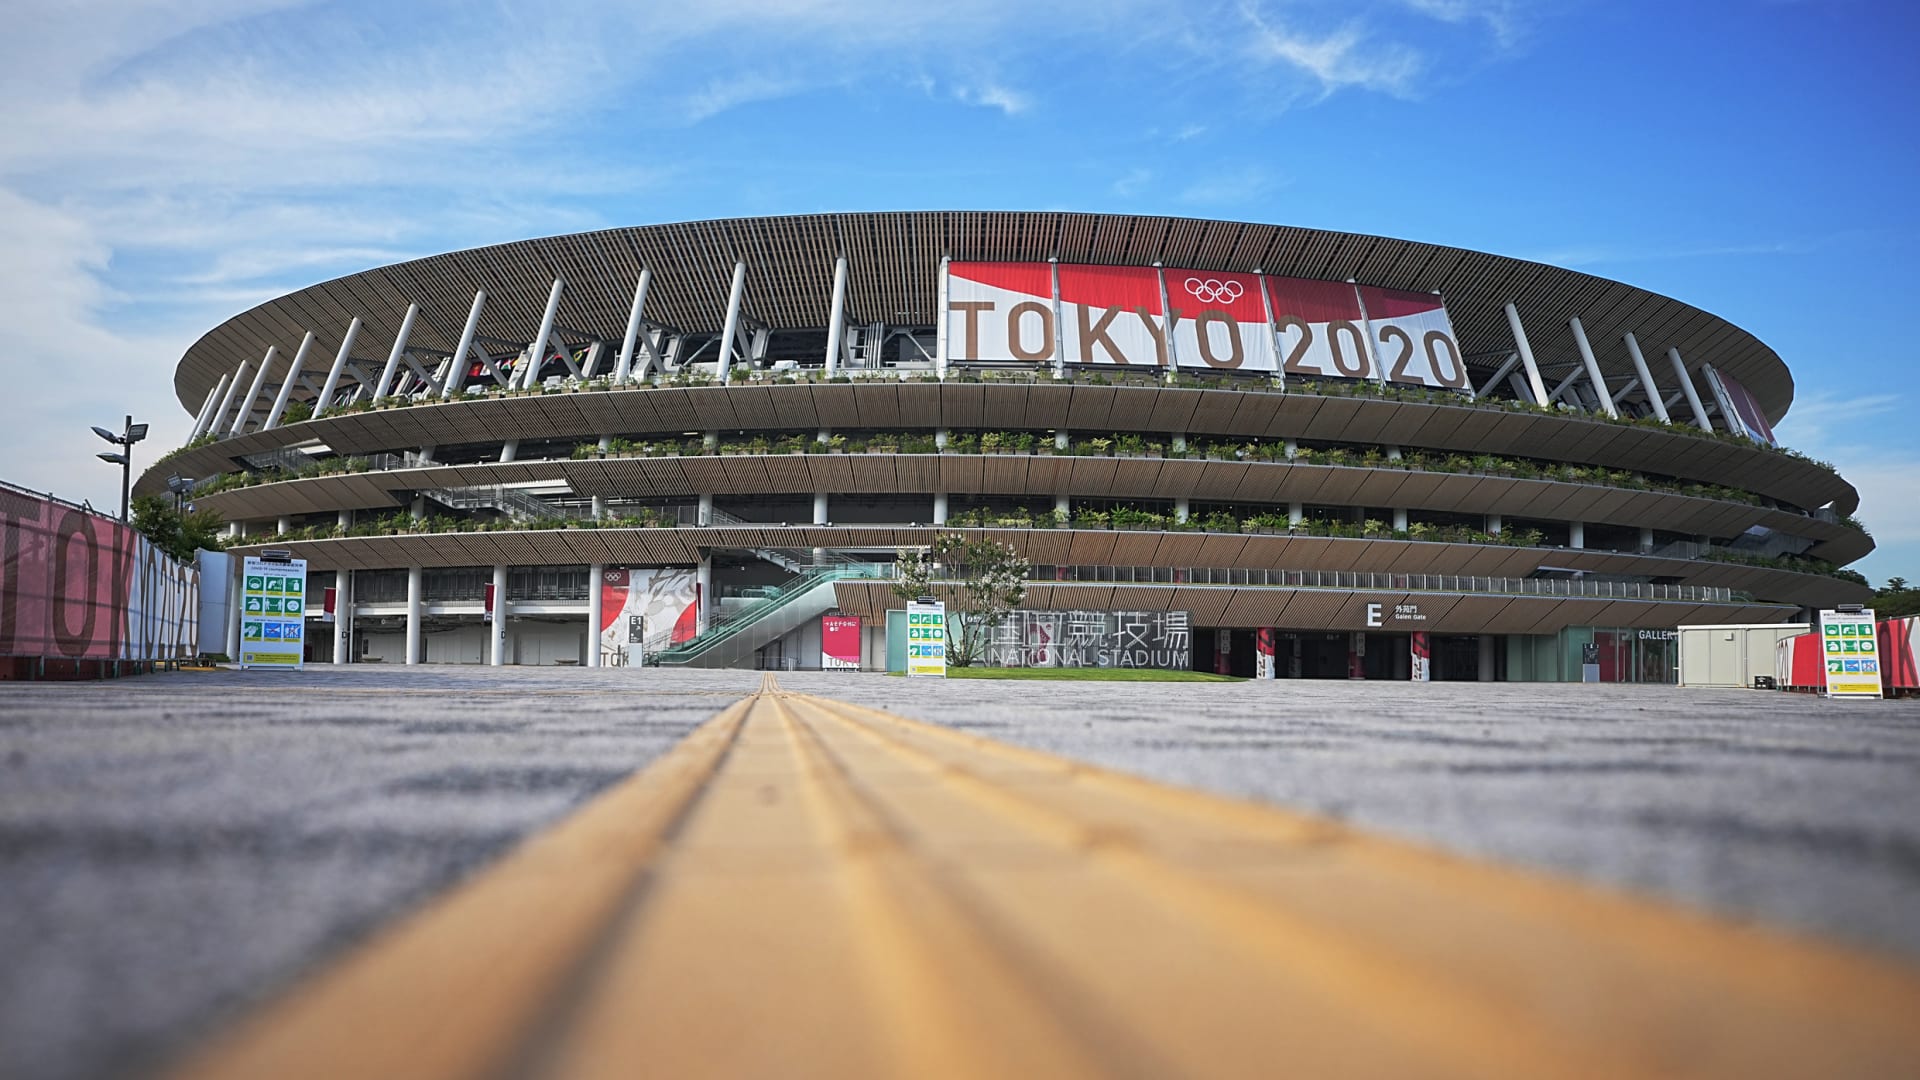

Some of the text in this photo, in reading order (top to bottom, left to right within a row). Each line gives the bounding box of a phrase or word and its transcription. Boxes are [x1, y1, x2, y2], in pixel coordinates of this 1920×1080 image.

[950, 300, 1466, 389] TOKYO 2020
[0, 491, 157, 660] TOKYO
[631, 616, 641, 625] E1
[990, 610, 1189, 648] 国立競技場
[1367, 603, 1382, 627] E
[990, 648, 1188, 669] NATIONAL STADIUM
